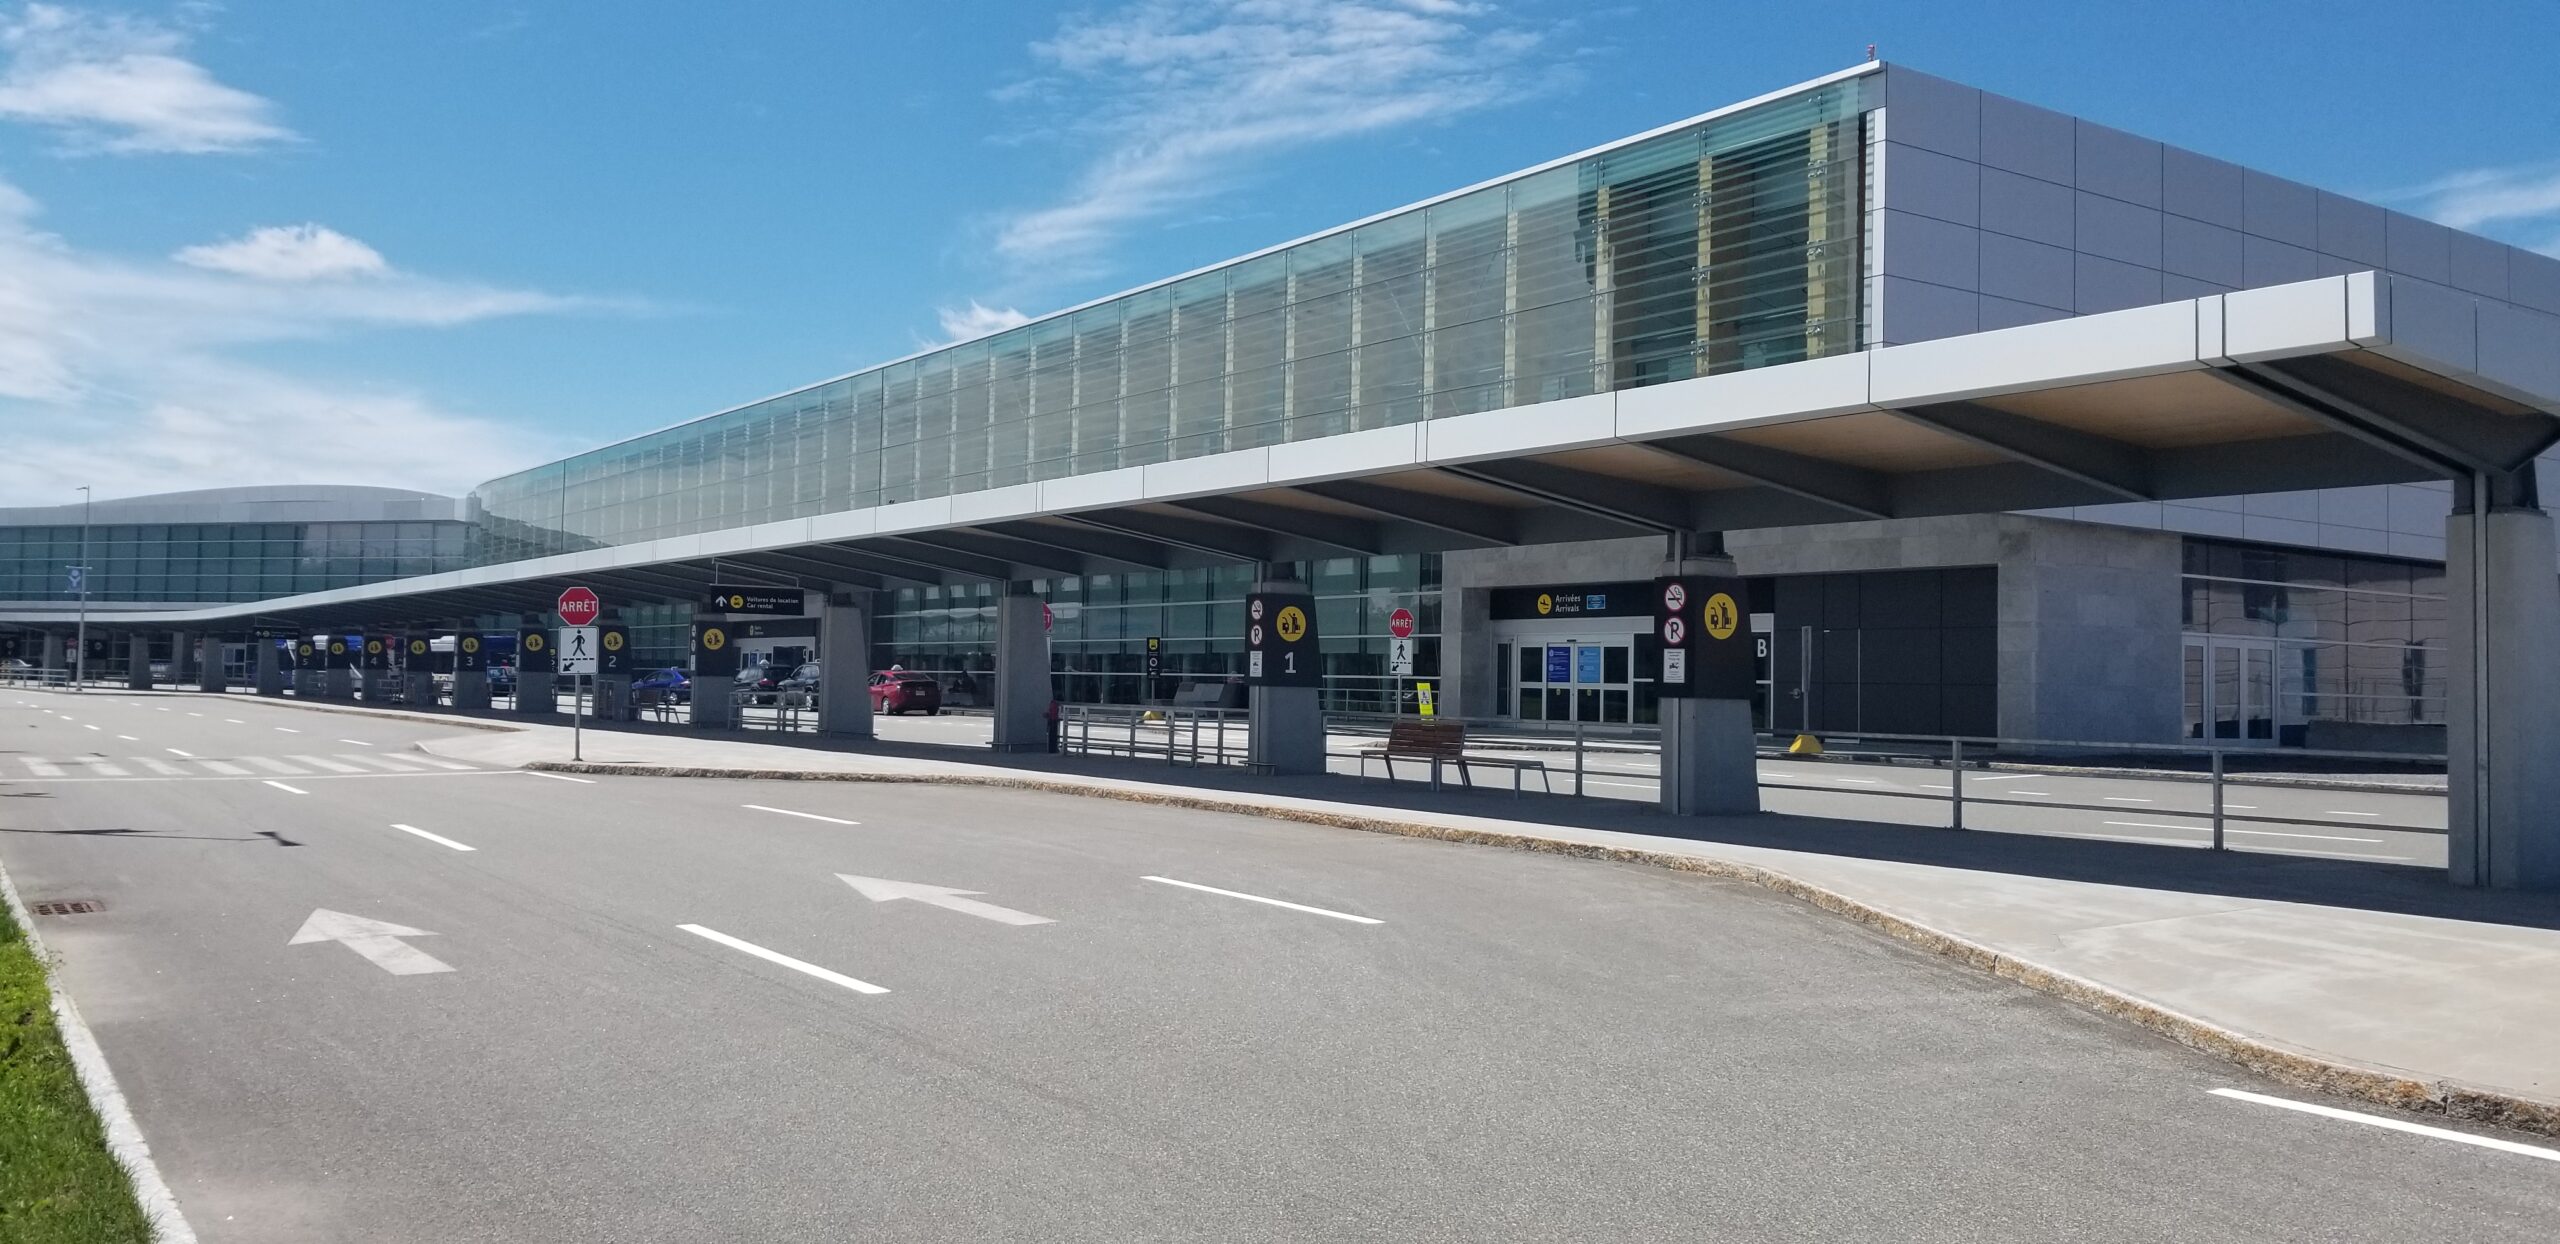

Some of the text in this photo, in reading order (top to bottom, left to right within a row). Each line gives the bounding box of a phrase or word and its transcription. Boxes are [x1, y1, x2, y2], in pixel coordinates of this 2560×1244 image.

[1555, 593, 1581, 603] Arrivées
[561, 598, 597, 613] ARRÊT
[1555, 604, 1580, 612] Arrivals
[1757, 638, 1767, 658] B
[370, 656, 377, 666] 4
[466, 656, 473, 666] 3
[608, 655, 617, 668] 2
[1284, 651, 1297, 674] 1
